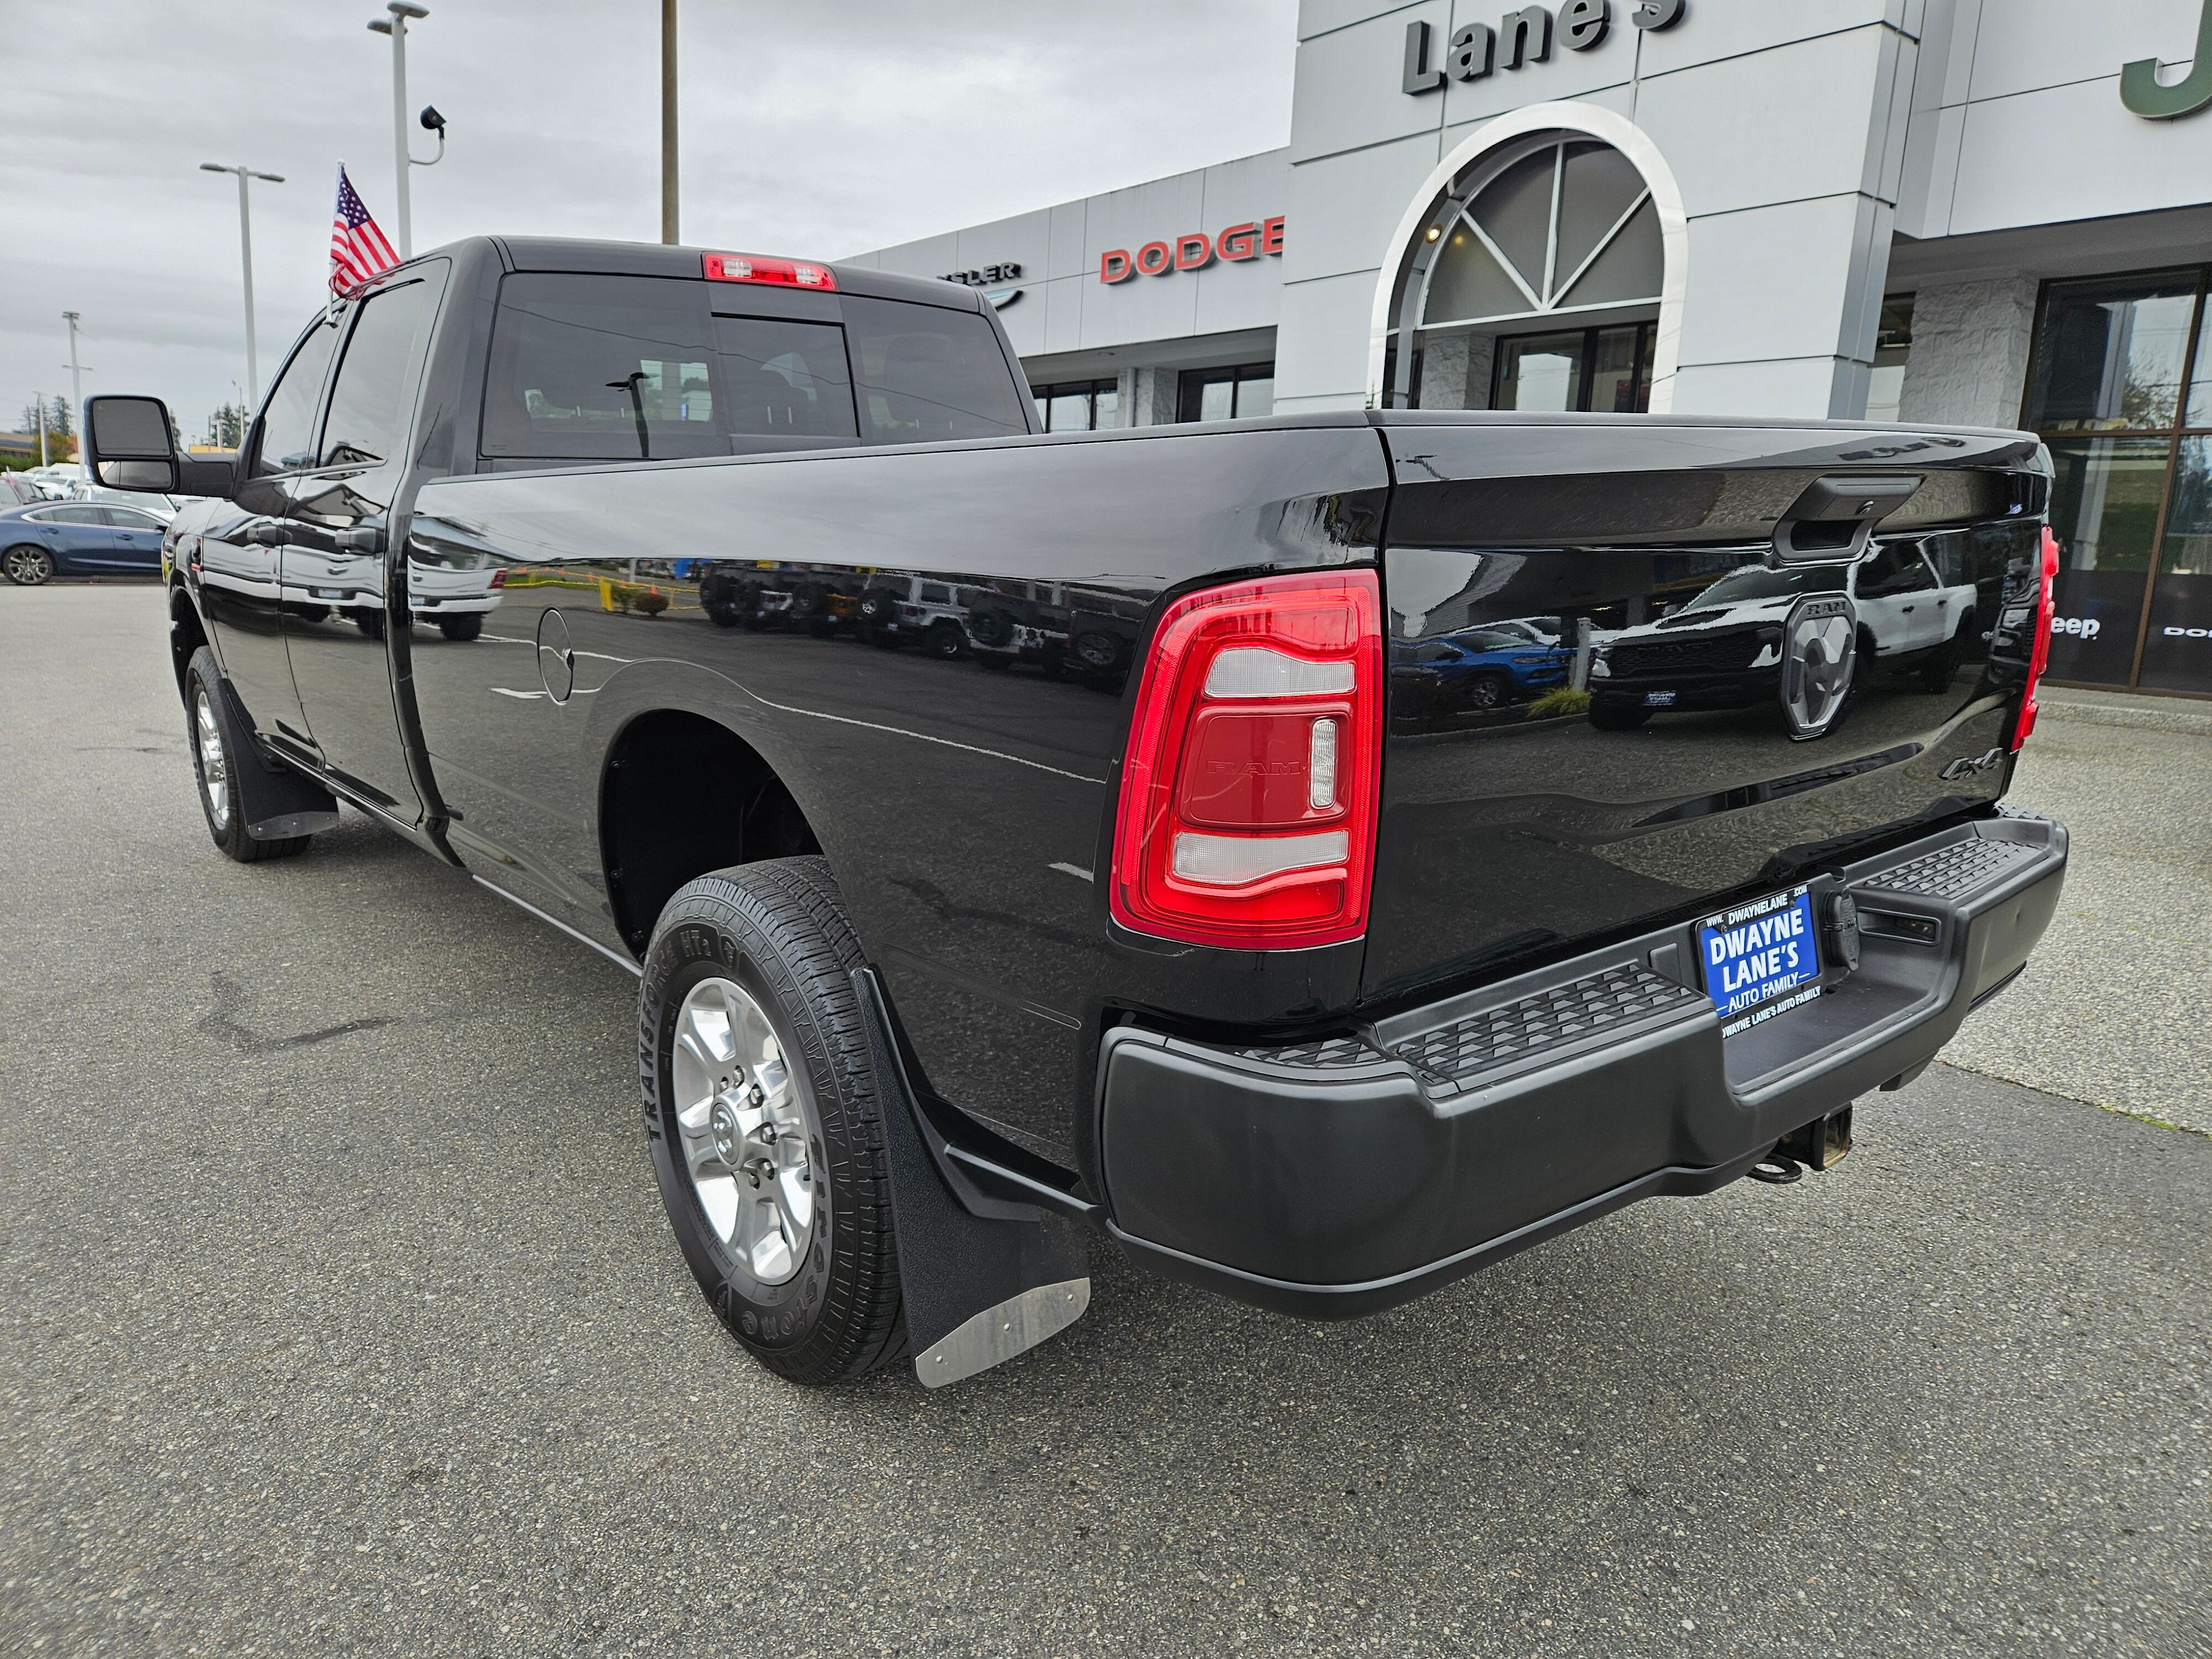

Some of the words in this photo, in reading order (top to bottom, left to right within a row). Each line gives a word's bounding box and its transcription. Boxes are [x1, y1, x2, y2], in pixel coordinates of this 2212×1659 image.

[1100, 215, 1285, 284] DODGE
[1807, 601, 1846, 615] RAM
[2051, 617, 2100, 640] eep
[2163, 627, 2212, 638] DO
[1207, 760, 1301, 775] RAM
[1728, 893, 1788, 925] DWAYNELANE
[1710, 909, 1804, 965] DWAYNE
[1723, 941, 1798, 993] LANE'S
[1728, 988, 1759, 1013] AUTO
[1762, 972, 1799, 997] FAMILY
[1777, 997, 1796, 1014] AUTO
[1795, 985, 1821, 1005] FAMILY
